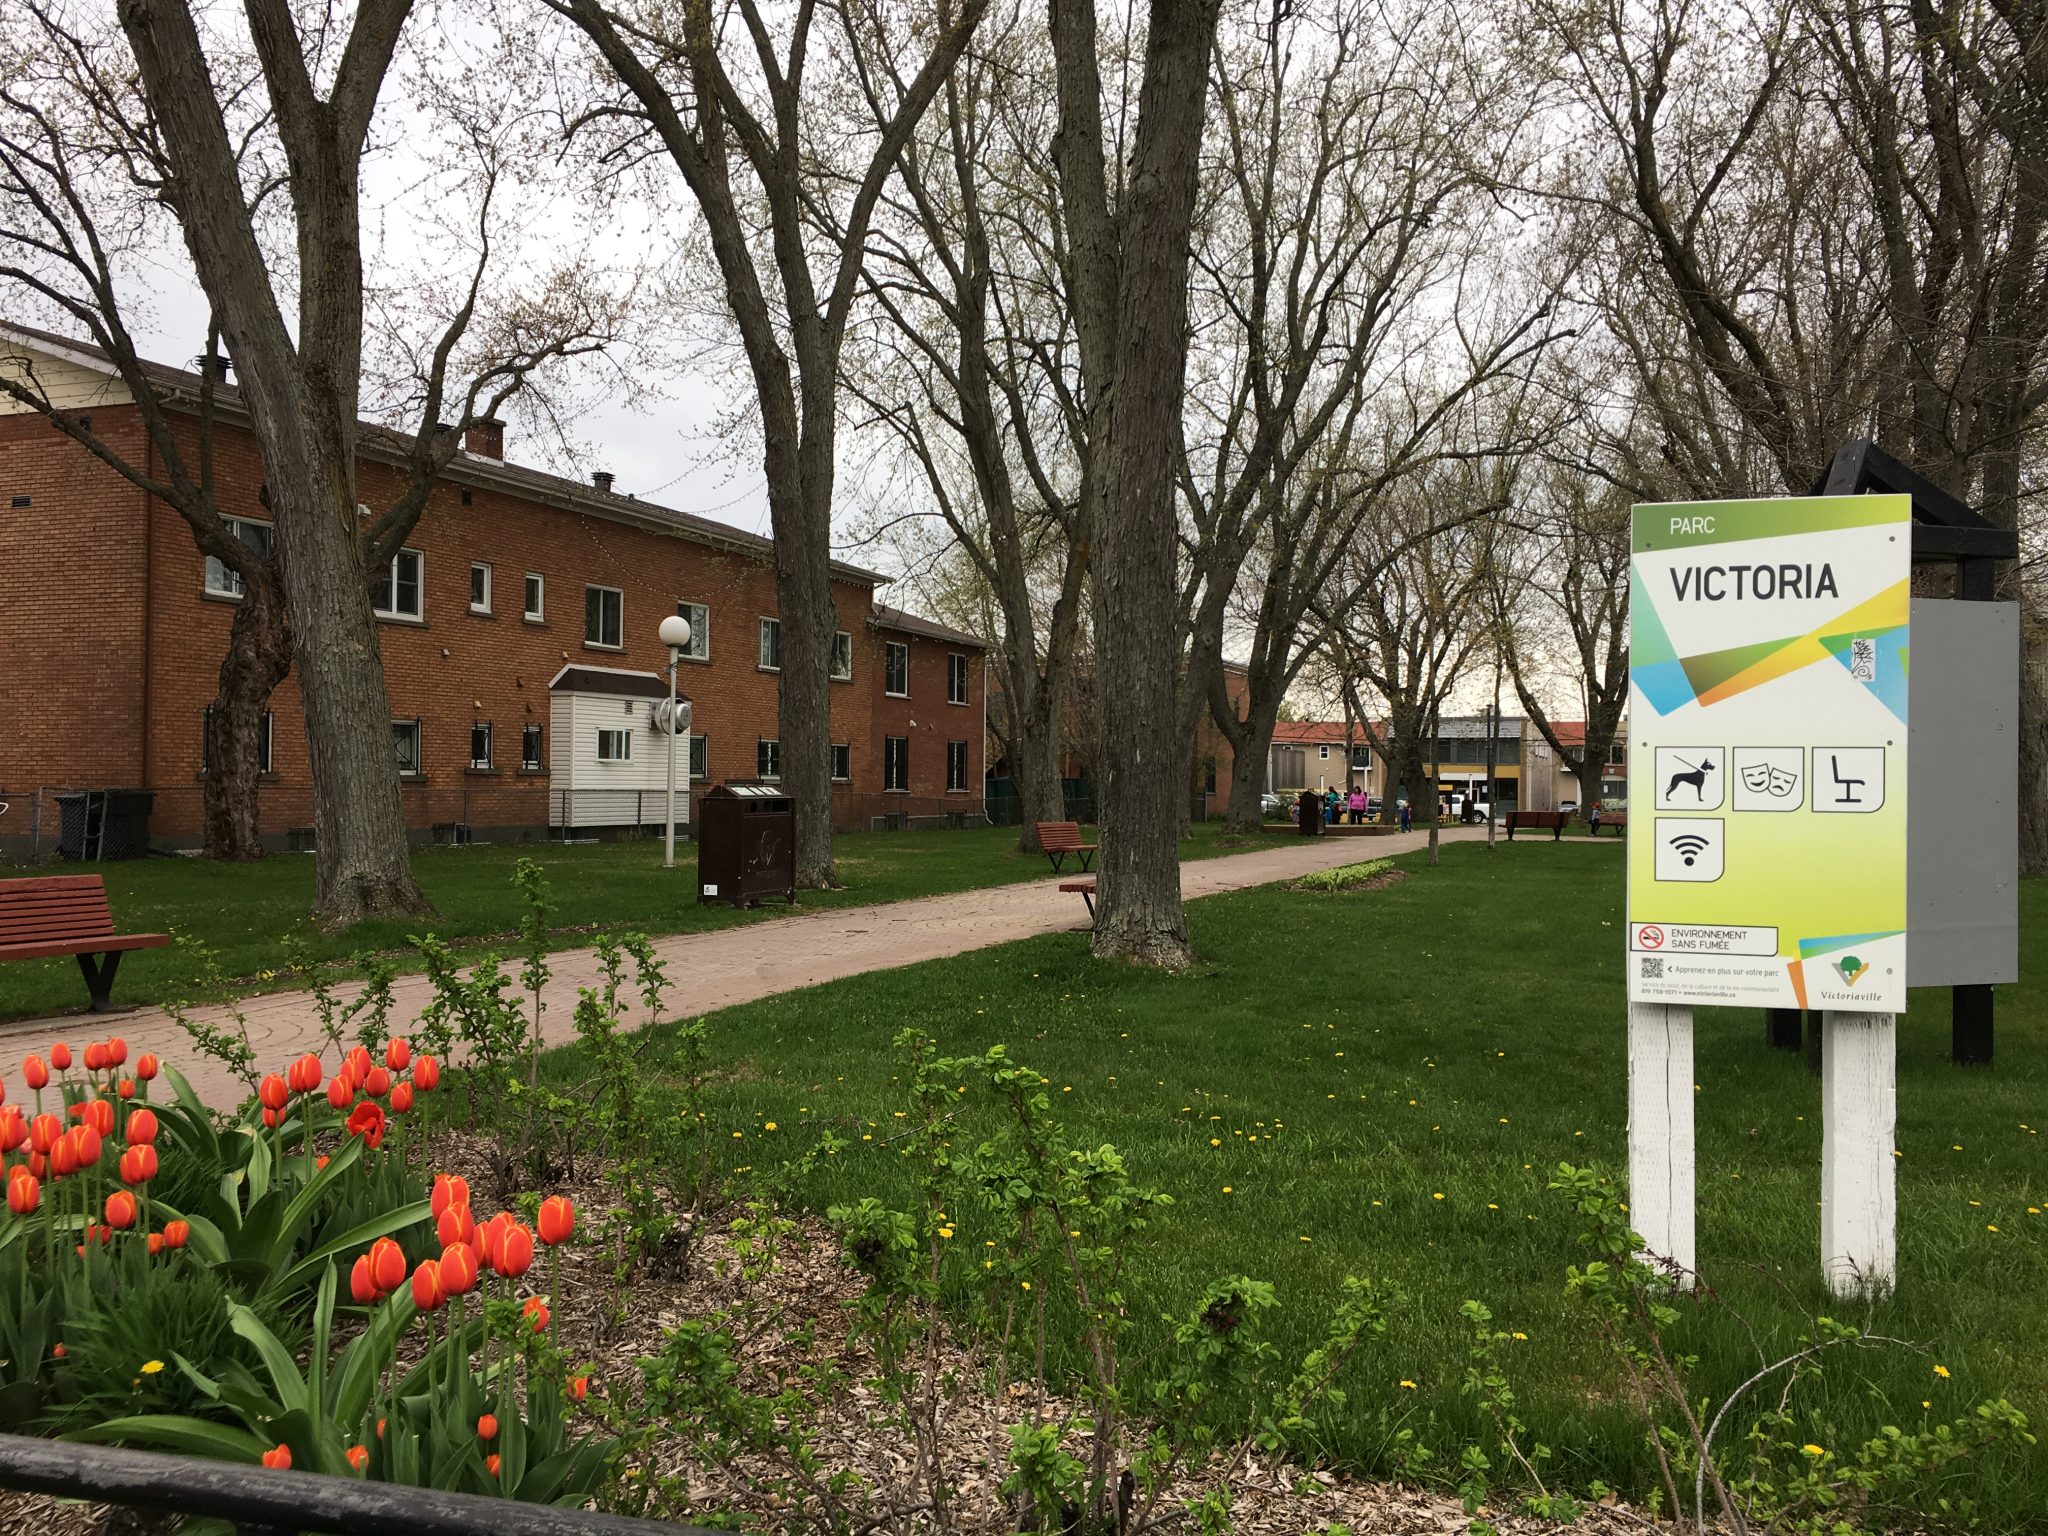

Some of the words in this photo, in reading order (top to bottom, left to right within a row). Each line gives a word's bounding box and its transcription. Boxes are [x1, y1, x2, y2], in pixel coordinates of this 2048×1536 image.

[1670, 516, 1715, 535] PARC
[1669, 563, 1839, 601] VICTORIA
[1671, 928, 1747, 940] ENVIRONNEMENT
[1671, 939, 1697, 949] SANS
[1699, 938, 1730, 950] FUMÉE
[1675, 966, 1716, 975] Apprenez-en
[1717, 967, 1731, 976] plus
[1745, 968, 1762, 976] votre
[1821, 991, 1882, 1001] Victoriaville
